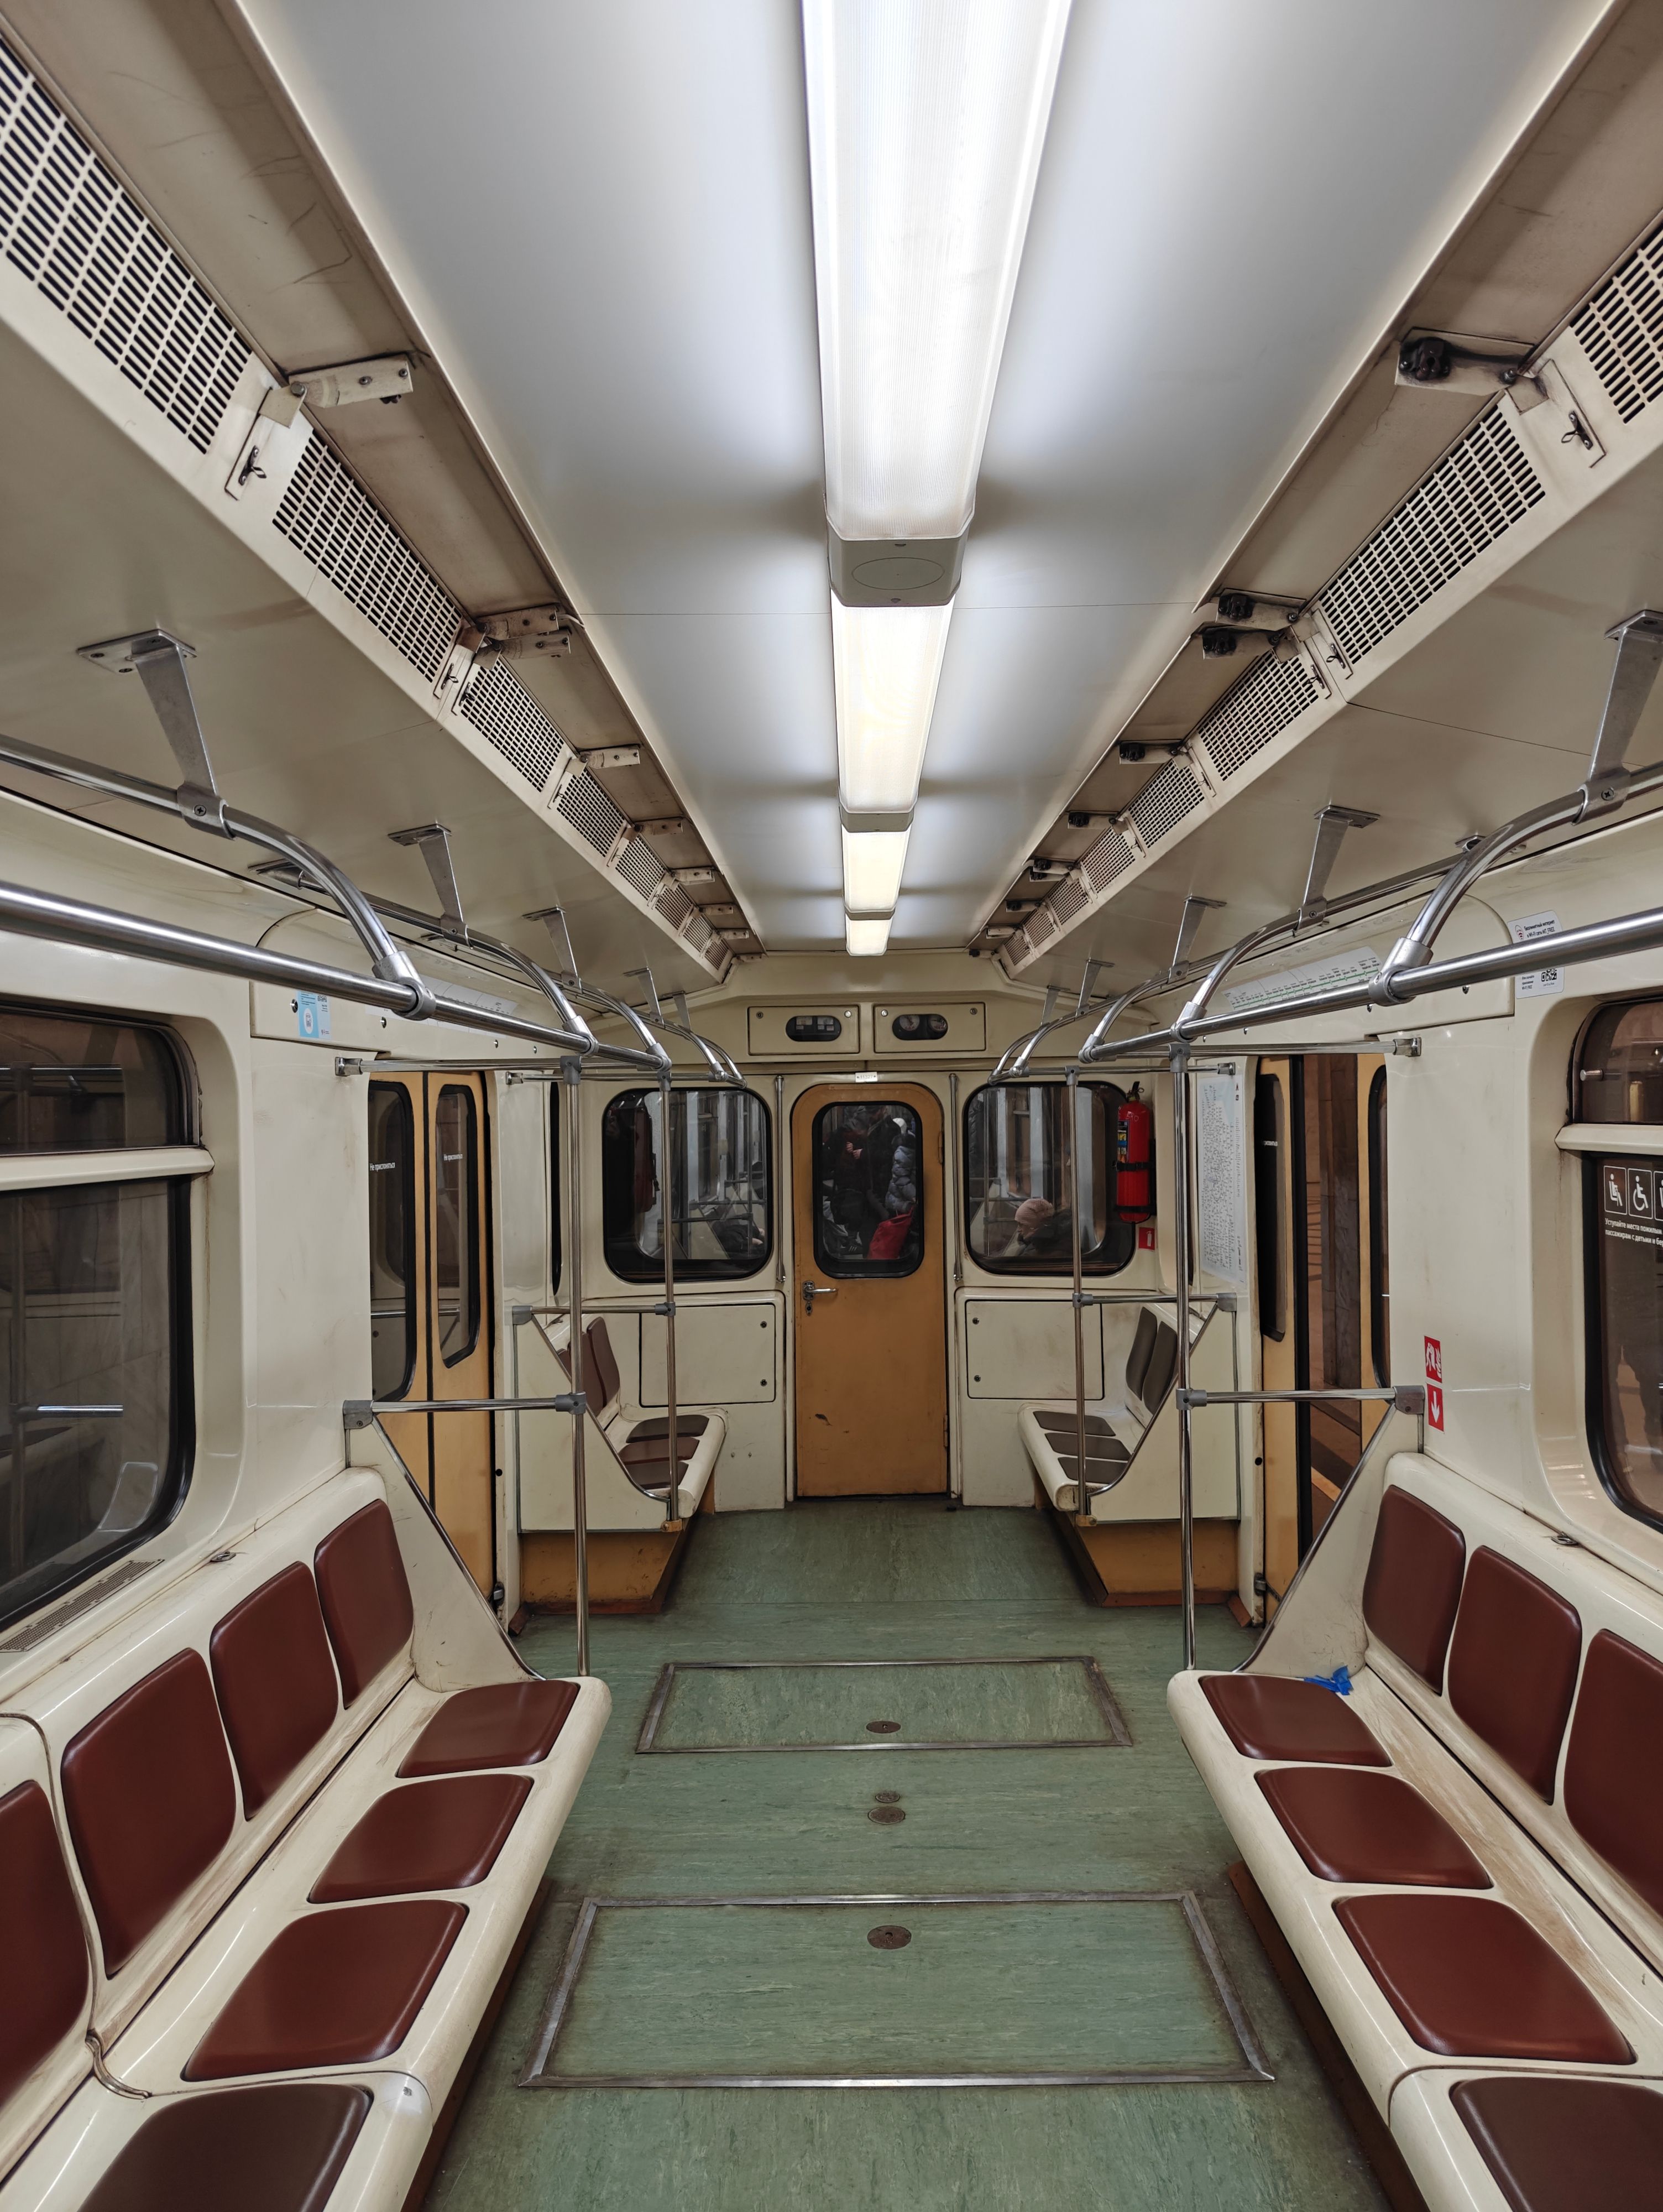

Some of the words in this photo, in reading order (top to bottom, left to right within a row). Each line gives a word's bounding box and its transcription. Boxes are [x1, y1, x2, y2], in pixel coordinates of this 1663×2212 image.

[375, 1162, 395, 1172] прислоняться
[1606, 1218, 1626, 1228] Уступайте
[1640, 1225, 1662, 1235] пожилым
[1605, 1229, 1631, 1239] пассажирам
[1635, 1235, 1651, 1243] детьми
